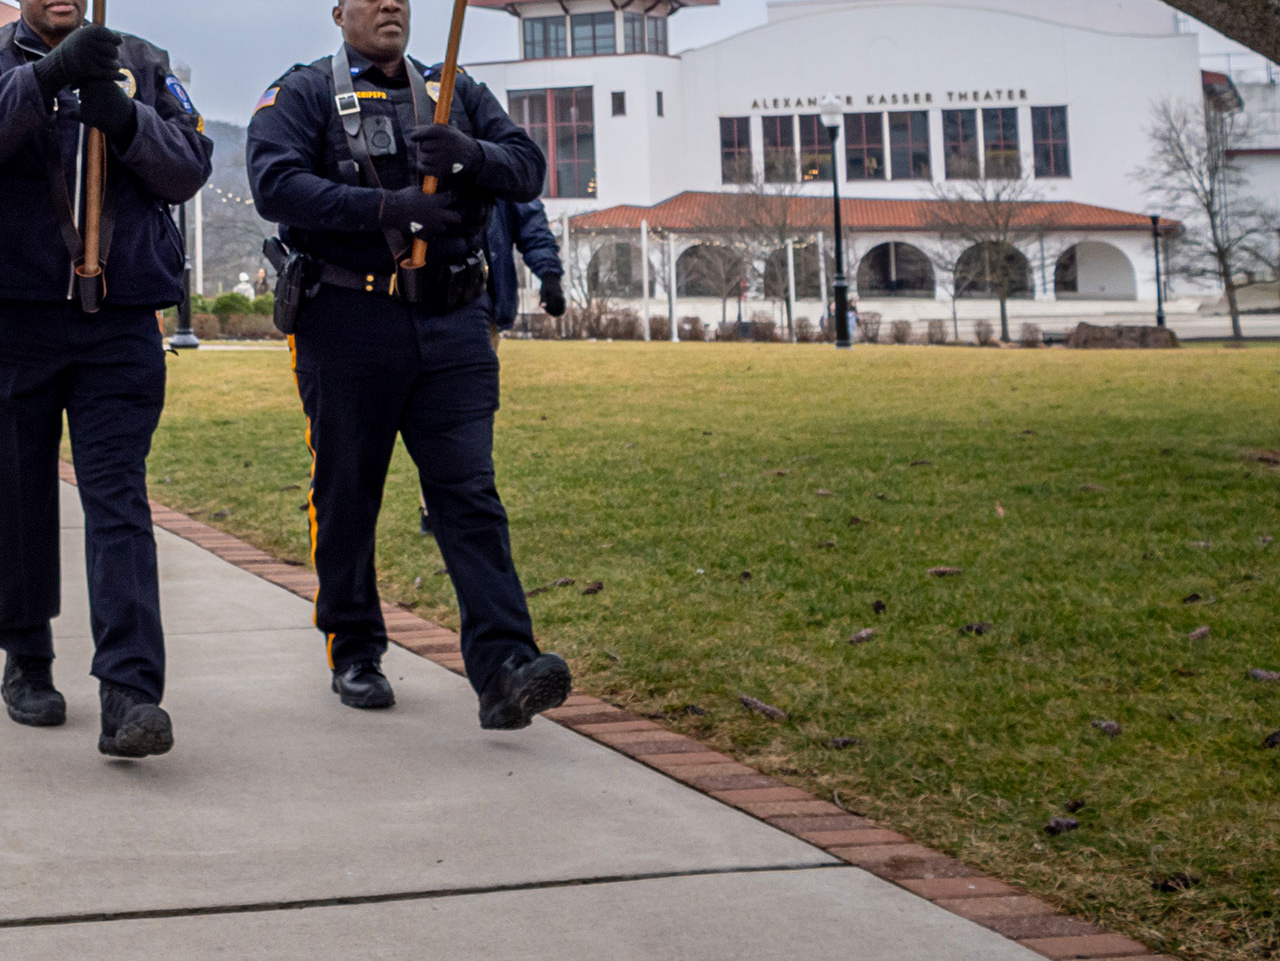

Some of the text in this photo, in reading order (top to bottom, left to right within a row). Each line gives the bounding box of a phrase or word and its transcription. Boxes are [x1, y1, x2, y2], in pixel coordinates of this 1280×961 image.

[751, 88, 1028, 110] ALEXANR KASSER THEATER
